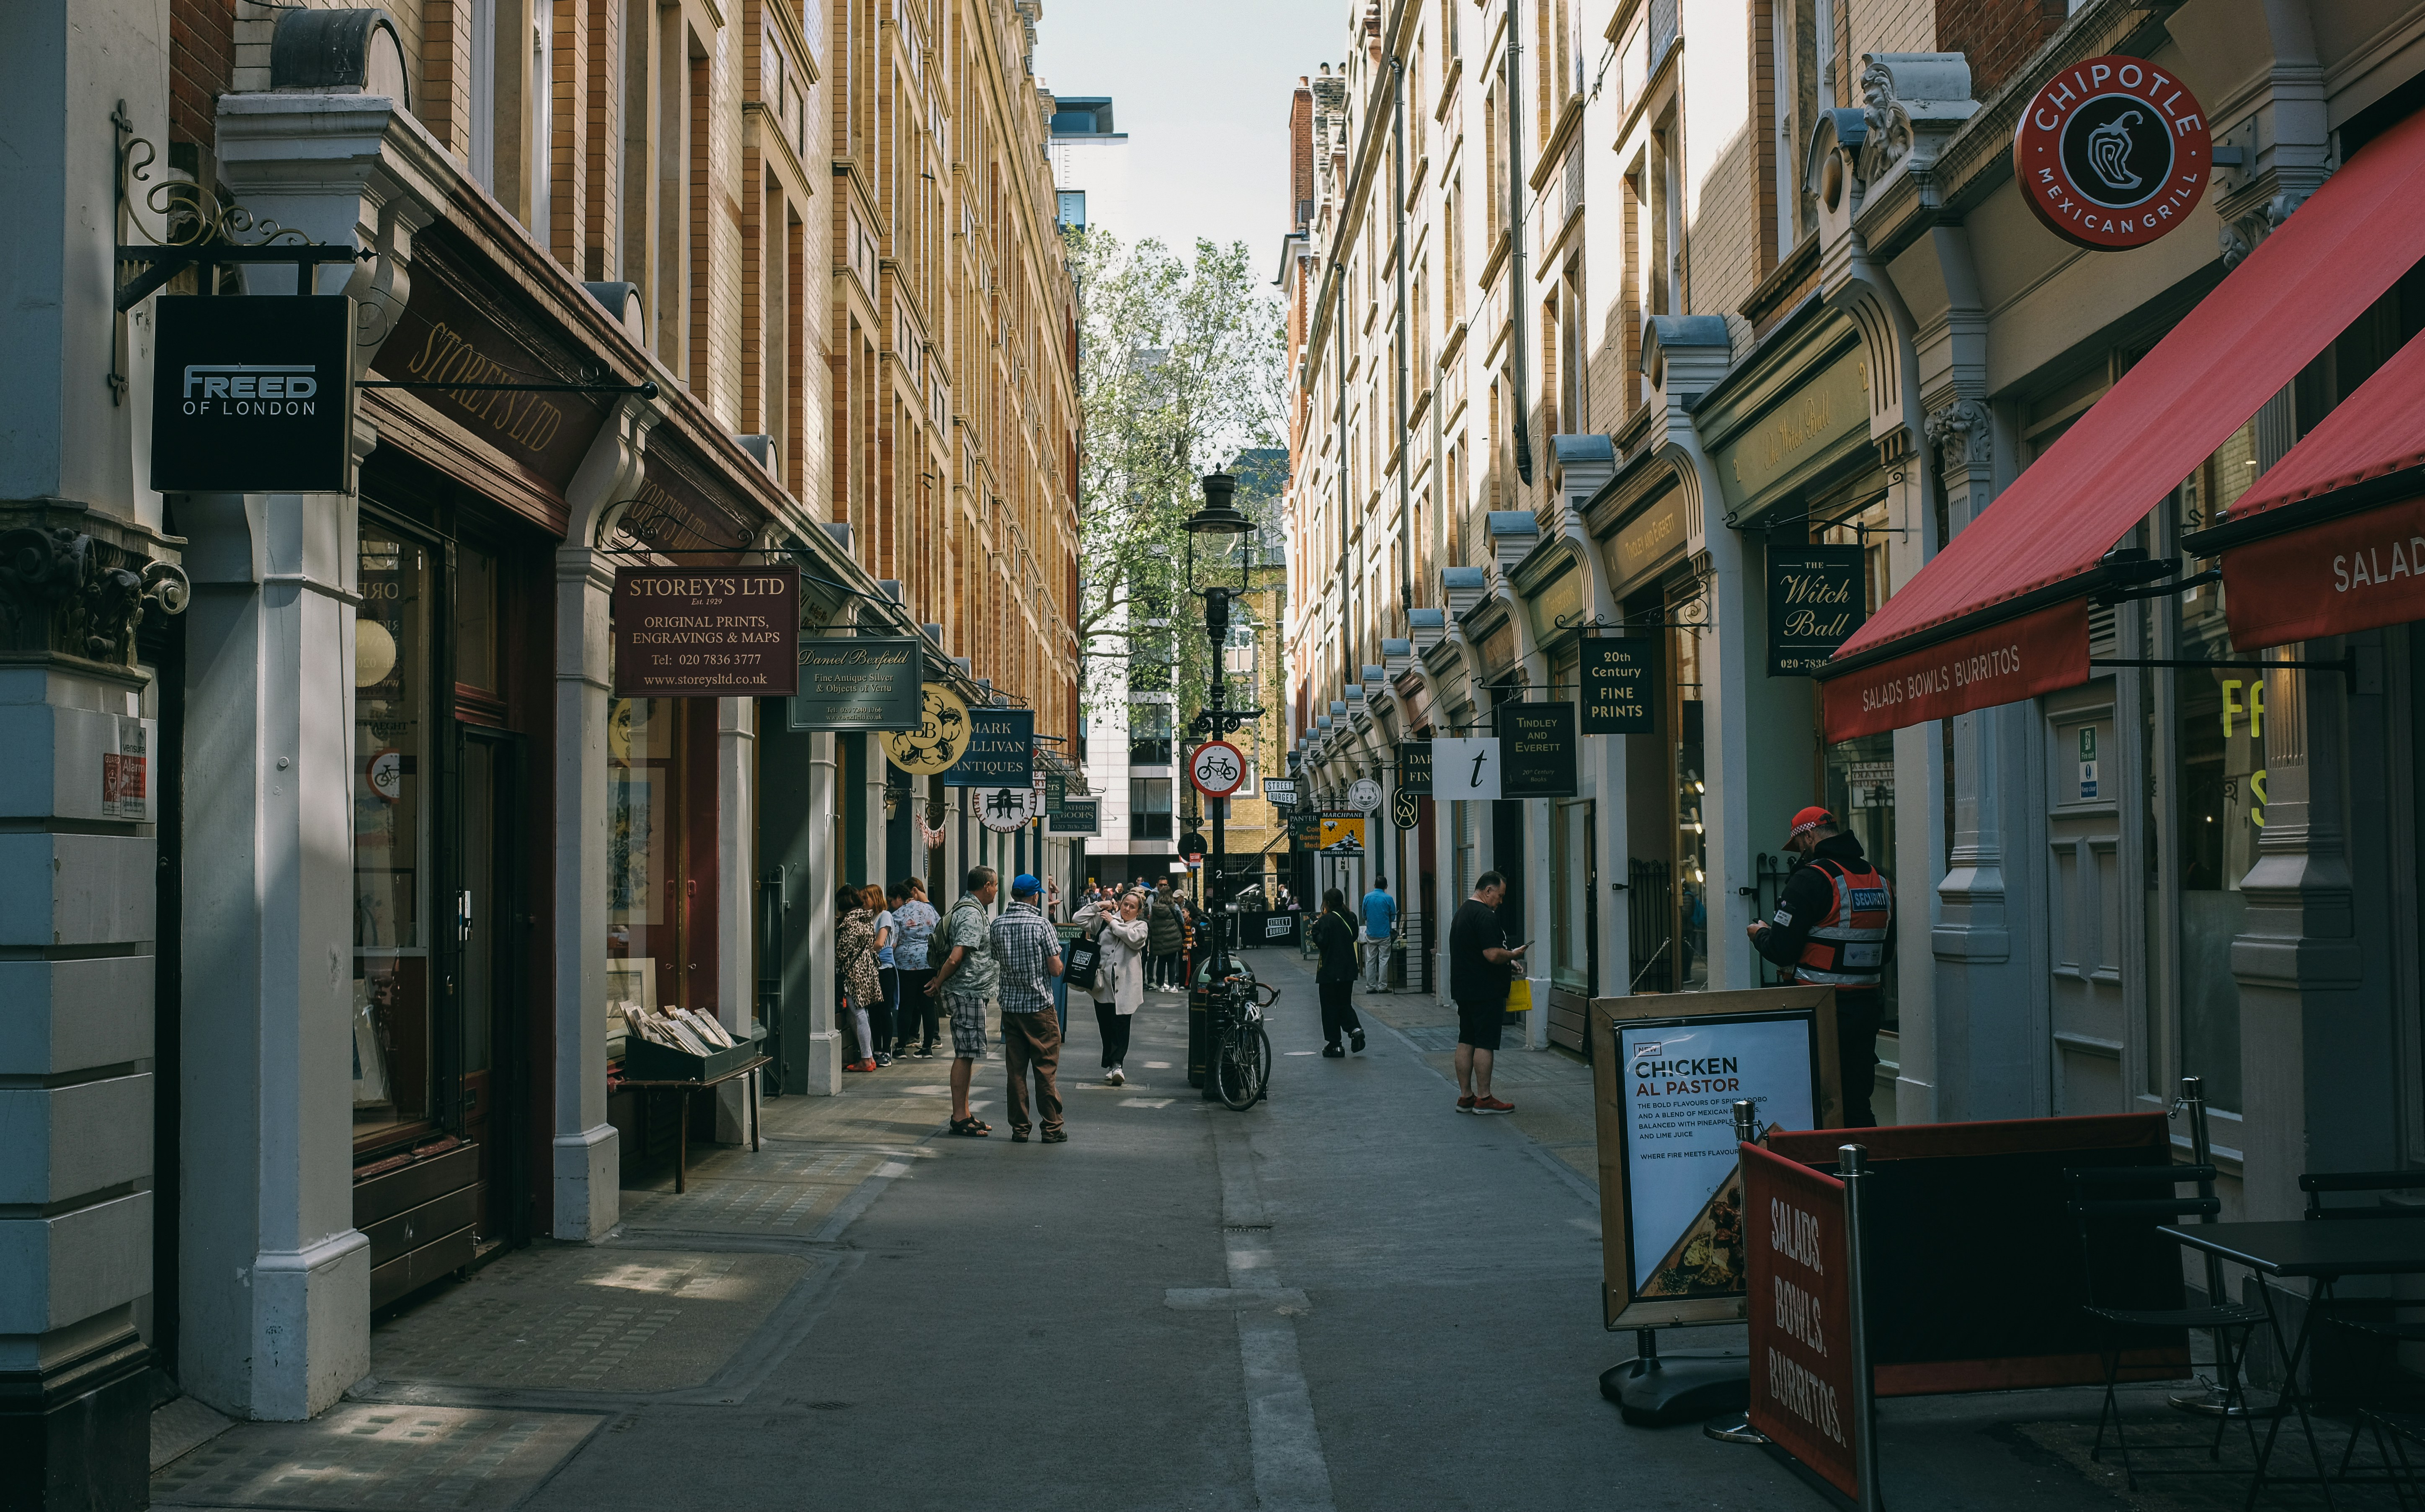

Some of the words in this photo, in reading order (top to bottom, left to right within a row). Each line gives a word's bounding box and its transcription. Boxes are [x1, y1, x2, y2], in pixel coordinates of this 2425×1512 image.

[2035, 64, 2201, 137] CHIPOTLE
[2038, 167, 2134, 234] MEXICAN
[2143, 173, 2198, 227] GRILL
[183, 365, 317, 398] FREED
[1859, 362, 1869, 392] 2
[407, 322, 519, 430] STOREY'S
[507, 394, 562, 452] LTD
[183, 402, 210, 415] OF
[223, 402, 315, 415] LONDON
[1777, 413, 1803, 456] Witch
[1804, 390, 1831, 440] Ball
[1733, 458, 1741, 483] 2
[625, 477, 688, 540] TOREY'S
[630, 578, 735, 596] STOREY'S
[743, 578, 784, 595] LTD
[1780, 575, 1850, 603] Witch
[645, 616, 713, 628] ORIGINAL
[717, 616, 769, 628] PRINTS,
[1784, 610, 1850, 636] Ball
[632, 632, 723, 644] ENGRAVINGS
[727, 633, 738, 643] &
[741, 632, 780, 643] MAPS
[652, 654, 672, 665] Tel:
[679, 654, 700, 665] 020
[704, 654, 731, 665] 7836
[734, 654, 761, 665] 3777
[798, 649, 849, 665] Daniel
[849, 649, 910, 670] Bexfield
[1604, 652, 1630, 662] 20th
[814, 674, 832, 682] Fine
[834, 674, 867, 683] Antique
[869, 673, 893, 682] Silver
[1592, 667, 1641, 678] Century
[1863, 679, 1903, 712] SALADS
[1907, 666, 1949, 700] BOWLS
[1955, 645, 2020, 687] BURRITOS
[644, 673, 767, 687] www.storeysltd.co.uk
[826, 684, 857, 694] Objects
[1601, 687, 1633, 699] FINE
[1592, 705, 1643, 718] PRINTS
[970, 723, 1011, 734] MARK
[1516, 718, 1557, 728] TINDLEY
[965, 741, 1025, 752] ULLIVAN
[1515, 742, 1561, 752] EVERETT
[123, 759, 145, 773] Alarm
[952, 762, 1023, 775] ANTIQUES
[1470, 750, 1487, 788] t
[1409, 772, 1432, 781] FIN
[1268, 782, 1291, 790] STREET
[1271, 793, 1294, 802] BURGER
[974, 793, 987, 824] MEDAL
[989, 814, 1030, 833] COMPANY
[1216, 870, 1223, 878] 2
[1855, 892, 1886, 907] SECURITY
[1635, 1056, 1738, 1079] CHICKEN
[1636, 1082, 1661, 1097] AL
[1667, 1078, 1739, 1095] PASTOR
[1771, 1196, 1823, 1276] SALADS.
[1775, 1275, 1827, 1358] BOWLS.
[1769, 1345, 1847, 1449] BURRITOS.
